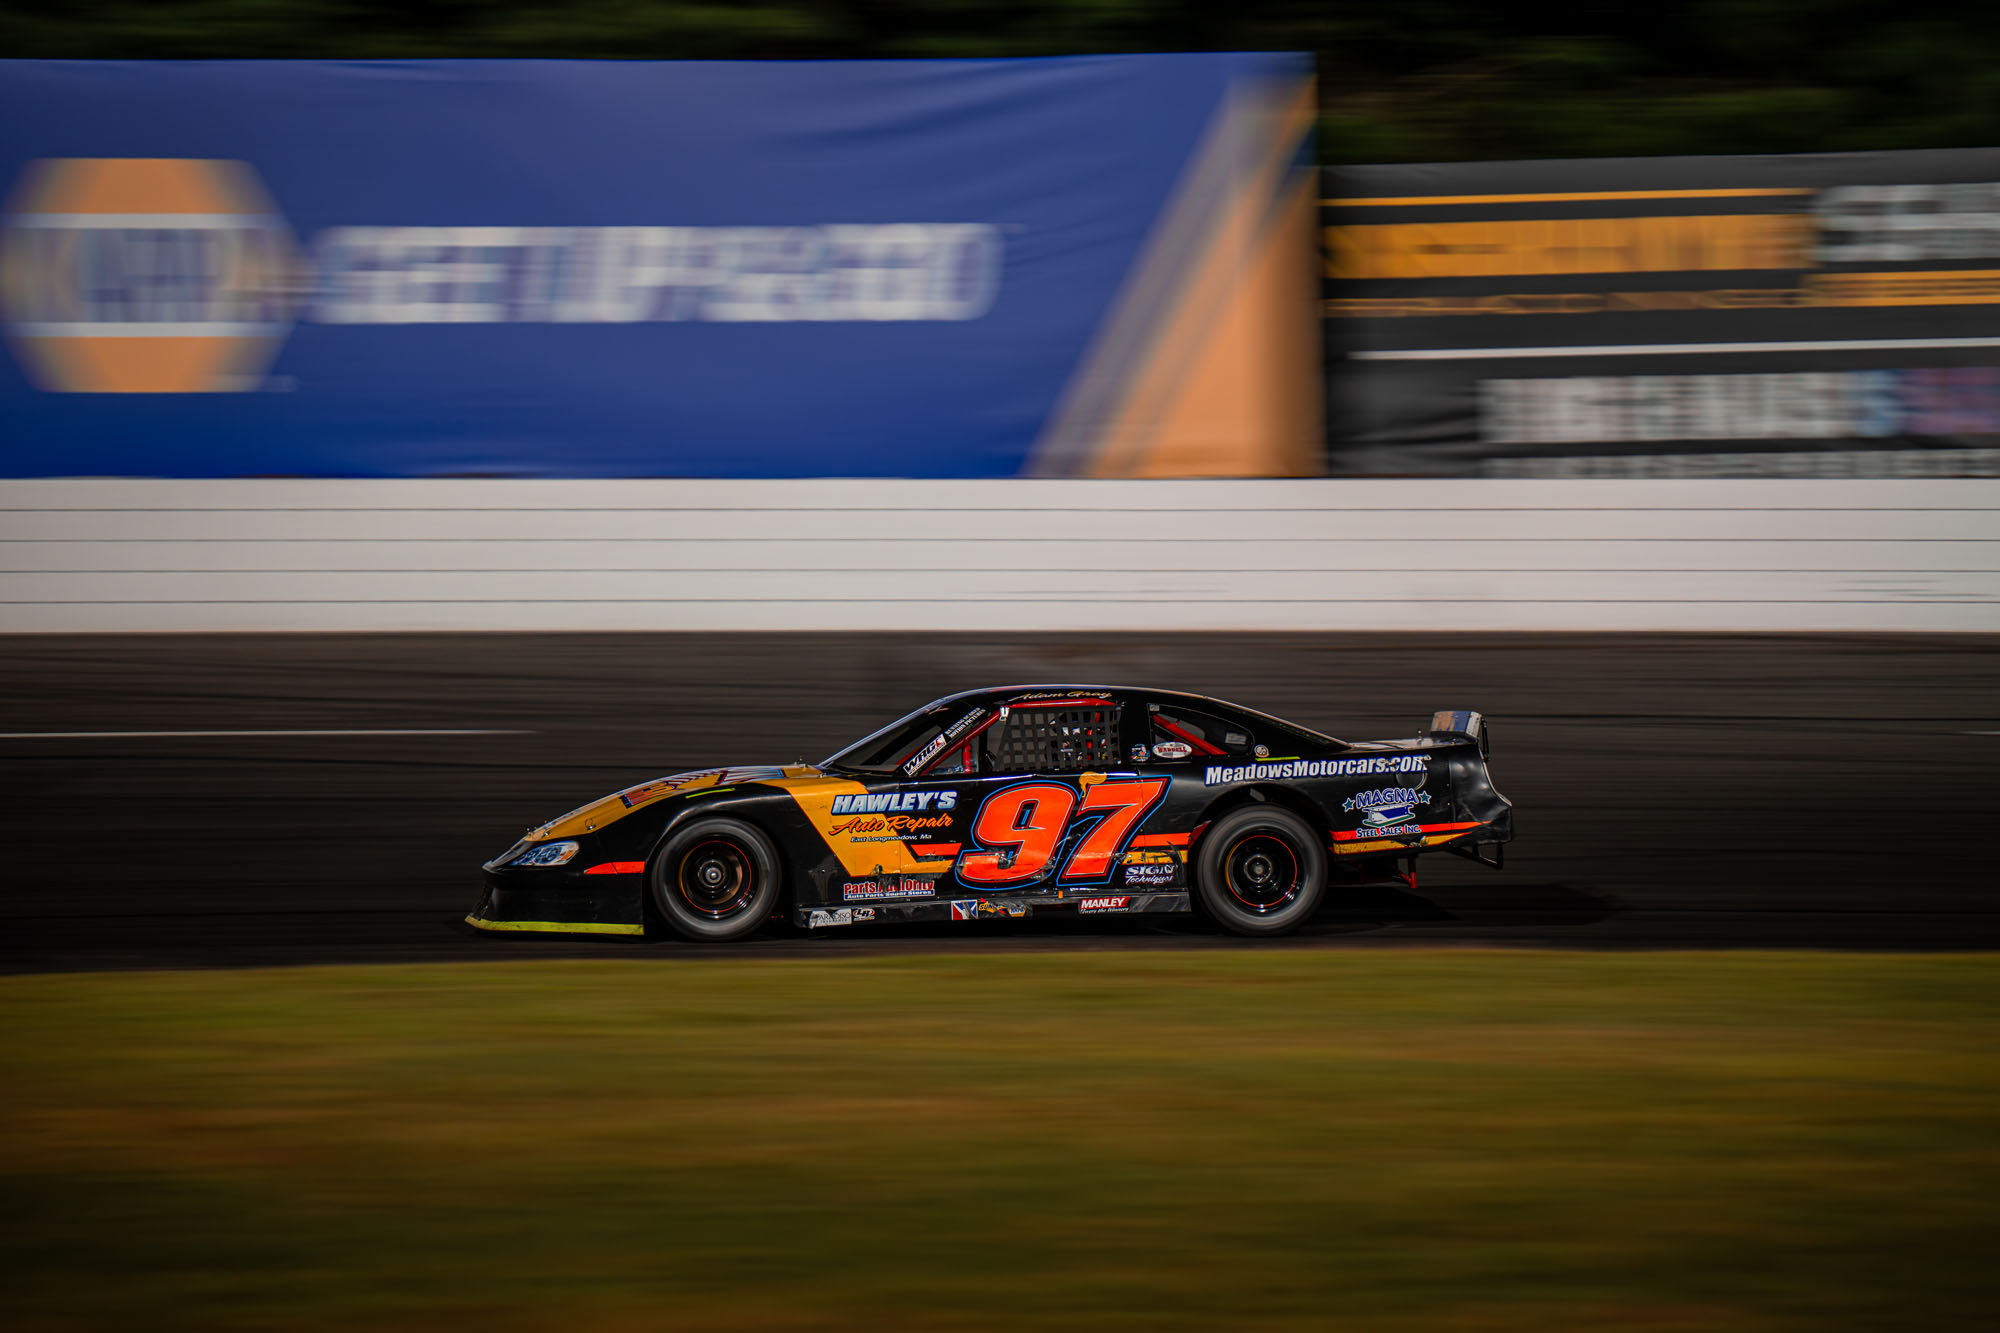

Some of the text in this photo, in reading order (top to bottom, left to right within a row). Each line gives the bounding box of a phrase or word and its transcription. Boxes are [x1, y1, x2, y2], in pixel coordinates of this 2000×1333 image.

[1204, 754, 1428, 786] MeadowsMotorcars.com
[831, 790, 958, 814] HAWLEY'S
[1355, 787, 1419, 809] MAGNA
[828, 812, 954, 836] Auto Repair
[956, 775, 1172, 890] 97
[1125, 864, 1175, 875] SIGN
[844, 882, 876, 895] Parts
[1081, 897, 1125, 909] MANLEY
